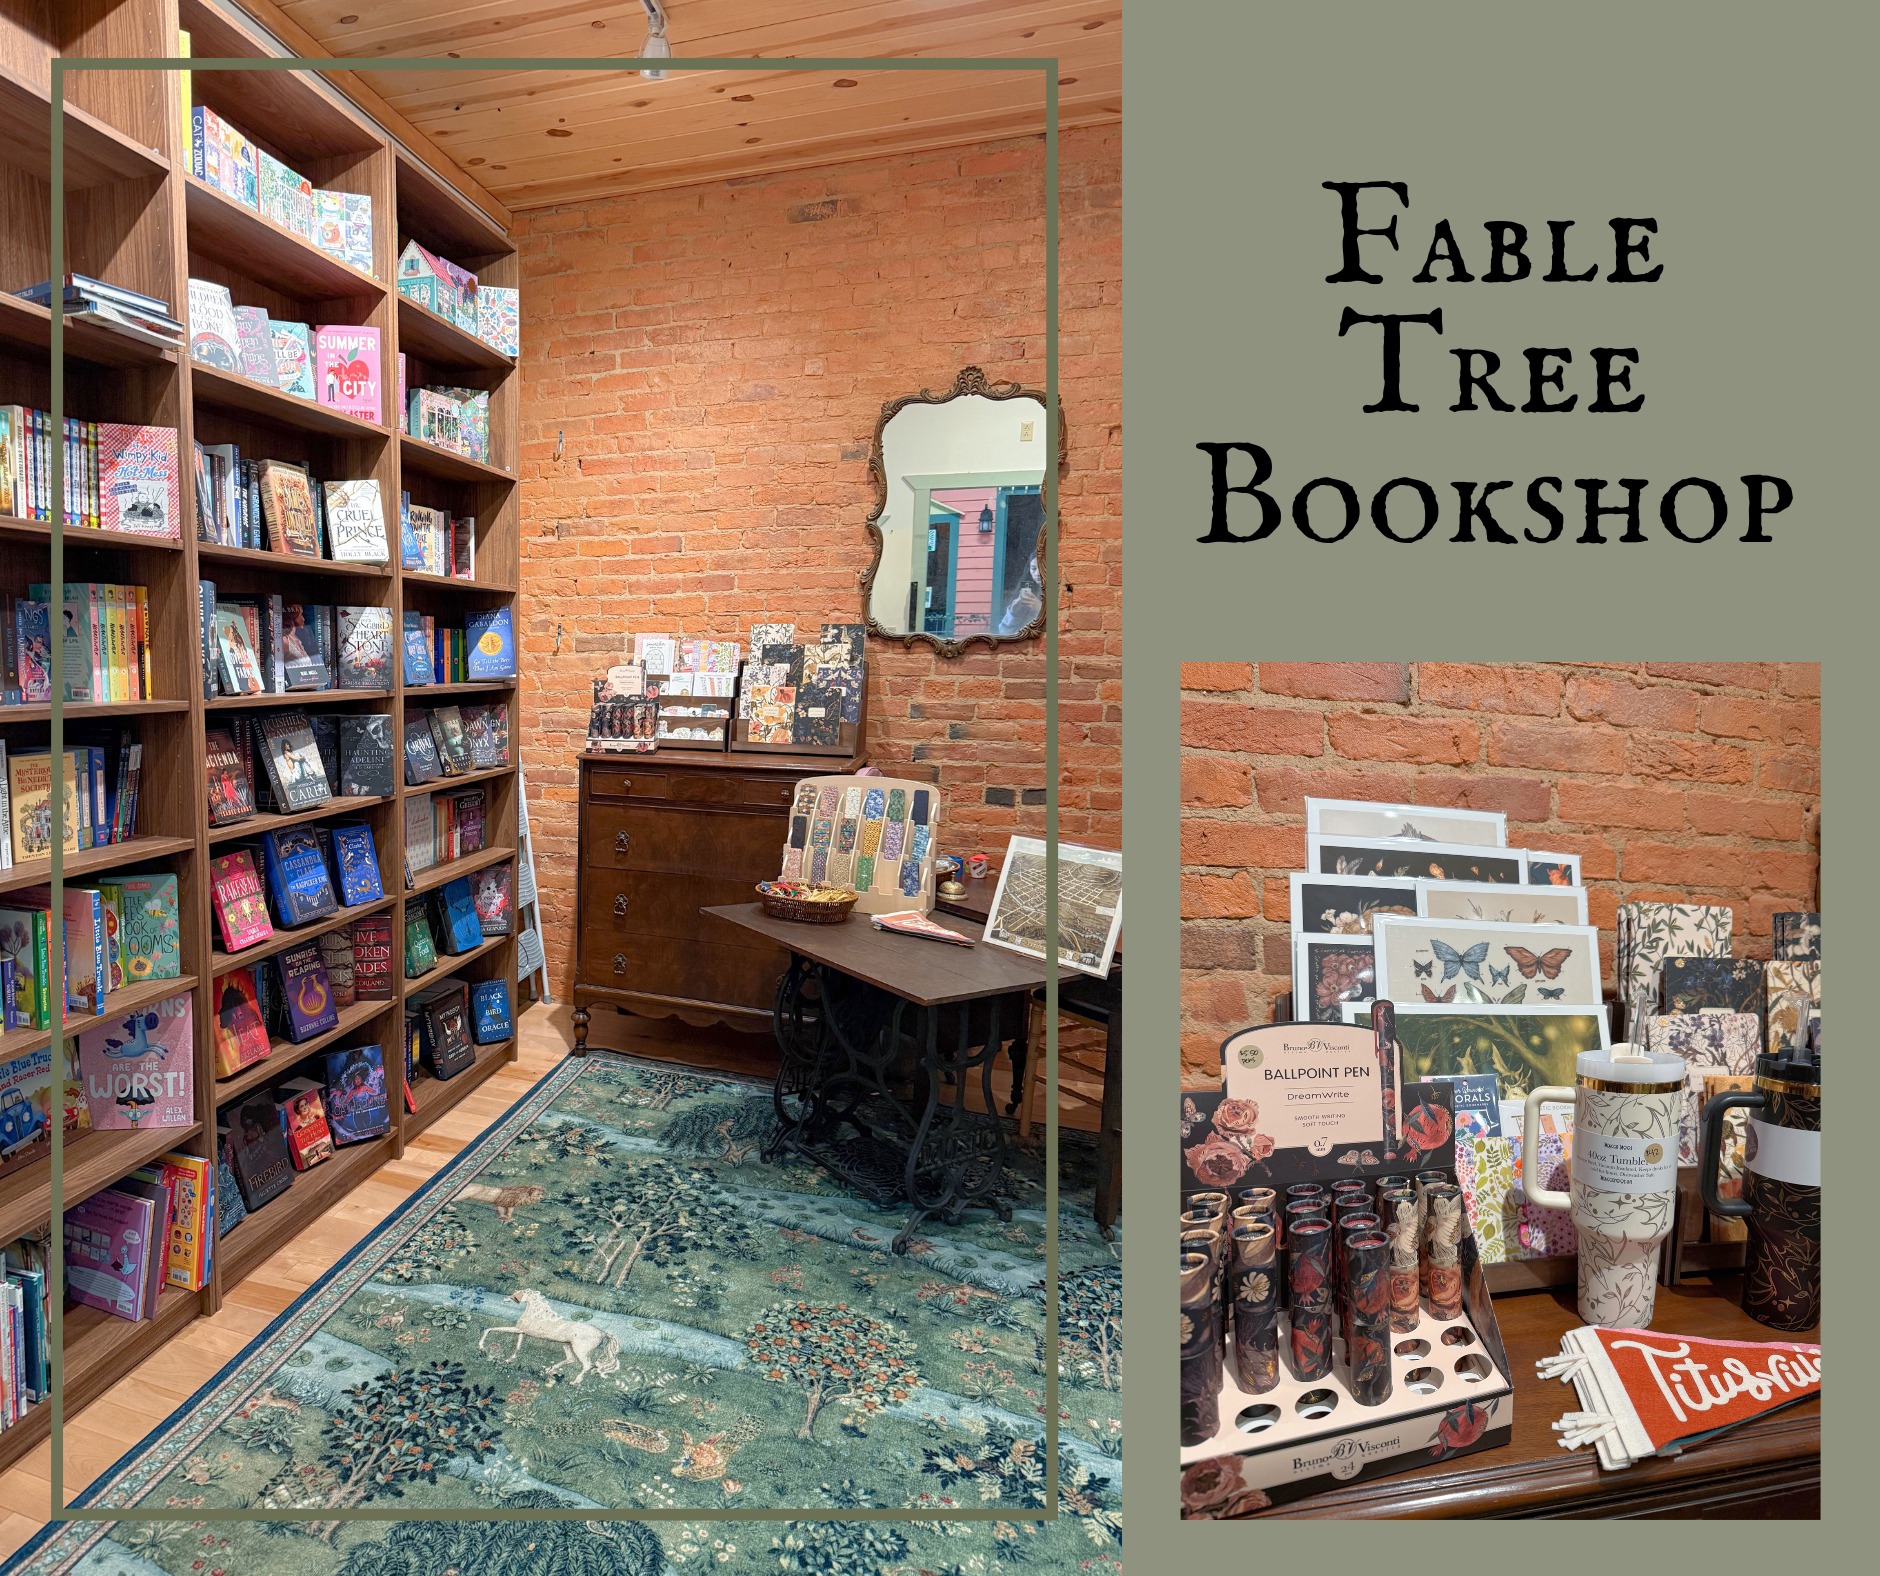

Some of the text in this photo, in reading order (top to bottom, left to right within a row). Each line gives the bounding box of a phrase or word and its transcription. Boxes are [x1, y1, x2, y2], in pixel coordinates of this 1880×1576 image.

[193, 115, 204, 176] CAT ZODIAC
[318, 335, 376, 351] SUMMER
[343, 381, 377, 396] CITY
[122, 432, 155, 441] DIARY
[112, 449, 168, 463] Wimpy Kid
[114, 465, 168, 479] Hot Mess
[336, 509, 374, 521] CRUEL
[337, 524, 385, 538] PRINCE
[468, 619, 509, 628] GABALDON
[356, 630, 389, 640] HEART
[344, 638, 389, 653] STONE
[208, 741, 219, 750] THE
[206, 751, 239, 768] ACIENDA
[289, 783, 329, 802] CAREY
[284, 853, 321, 871] CASSANDRA
[297, 866, 316, 878] CLARE
[124, 921, 149, 935] OOK
[355, 930, 377, 943] IVE
[129, 934, 174, 956] OOMS
[354, 946, 390, 957] OKEN
[94, 944, 102, 964] Blue
[285, 948, 318, 965] SUNRISE
[288, 960, 321, 978] REAPING
[355, 961, 388, 973] ADES
[95, 964, 103, 993] Truck
[480, 992, 503, 1002] BLACK
[485, 1008, 502, 1016] BIRD
[424, 1012, 436, 1048] MYTHOLOGY
[481, 1021, 509, 1033] ORACLE
[12, 1050, 51, 1075] Blue Truc
[112, 1061, 159, 1072] ARE THE
[12, 1064, 50, 1085] Racer Red
[1264, 1066, 1370, 1080] BALLPOINT PEN
[89, 1071, 186, 1100] WORST!
[1287, 1091, 1350, 1101] DreamWrite
[1455, 1093, 1491, 1103] ORALS
[165, 1106, 183, 1115] ALEX
[162, 1114, 186, 1122] WILLAN
[1587, 1150, 1607, 1162] 40oz
[1610, 1338, 1821, 1423] Titusvill
[1292, 1436, 1401, 1470] Bruno Visconti
[1340, 1461, 1356, 1474] 24
